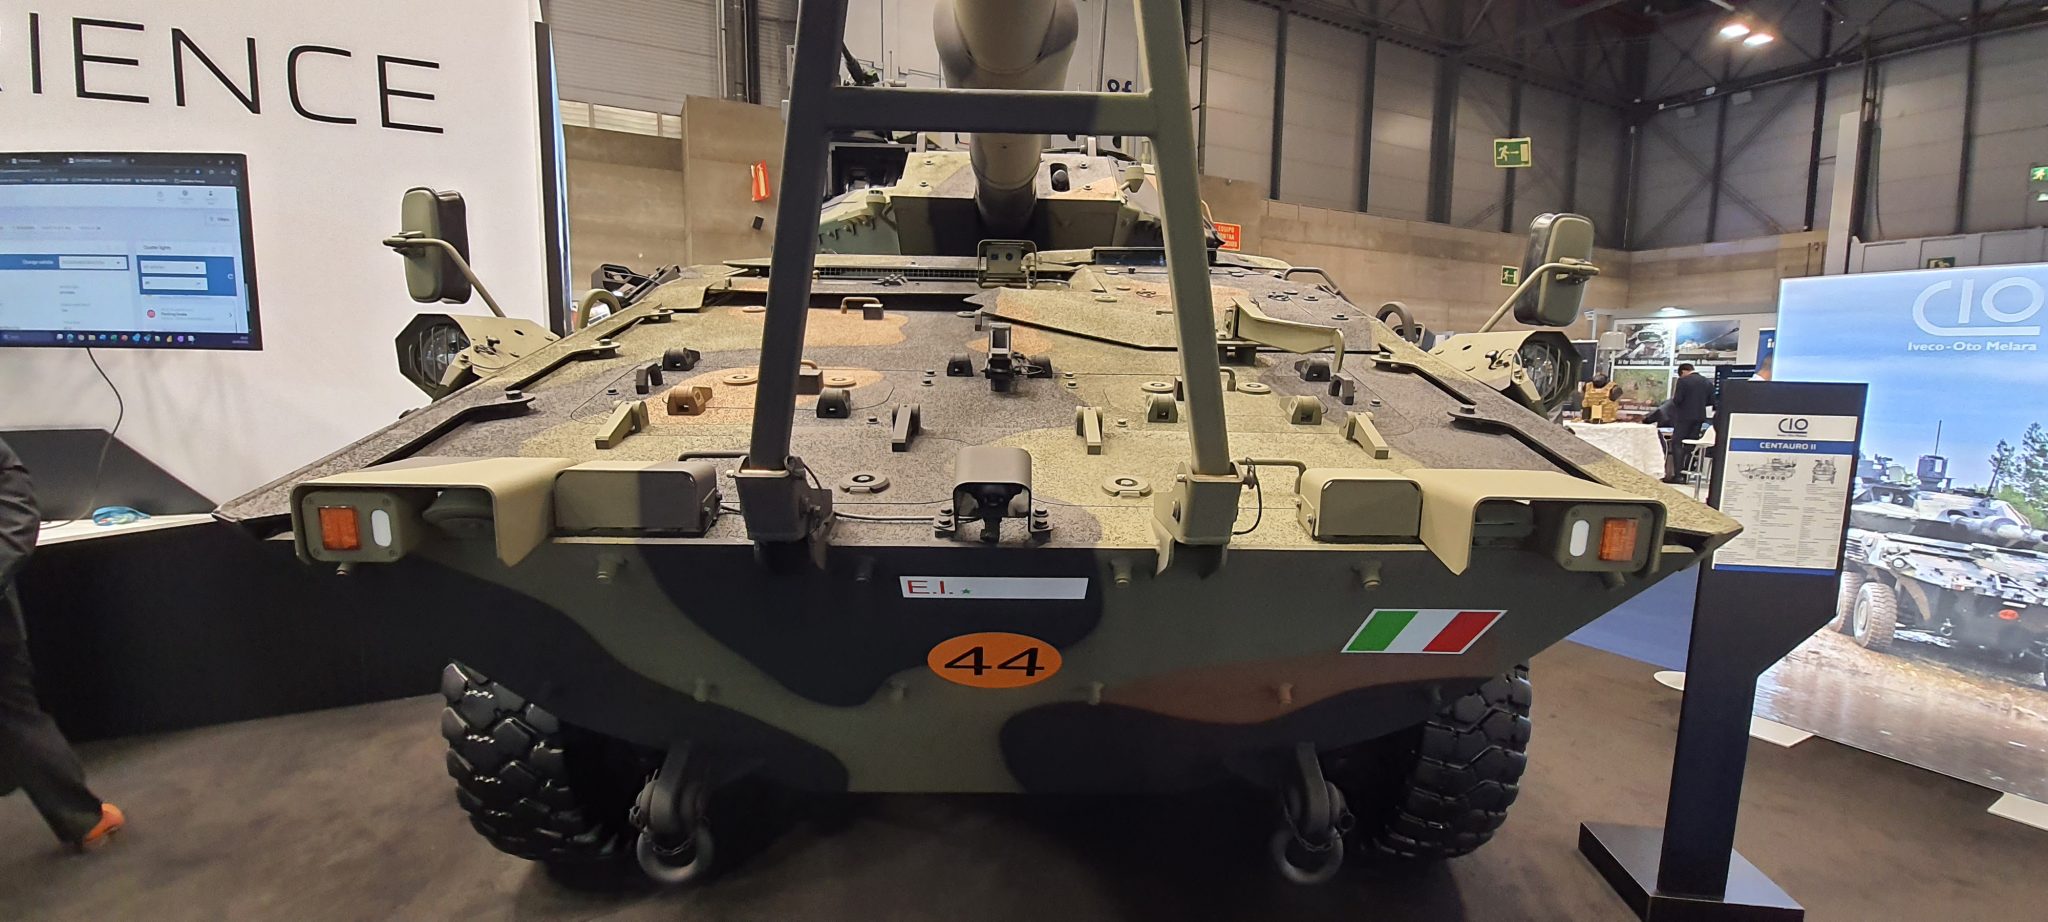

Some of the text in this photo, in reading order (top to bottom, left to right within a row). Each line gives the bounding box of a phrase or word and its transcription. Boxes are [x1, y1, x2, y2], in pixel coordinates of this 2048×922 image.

[0, 11, 444, 134] IENCE
[1911, 276, 2045, 337] CIO
[1985, 341, 2038, 351] Melara
[1778, 418, 1809, 434] CIO
[1759, 441, 1809, 450] CENTAURO
[907, 580, 954, 595] E.I.
[944, 646, 1045, 677] 44
